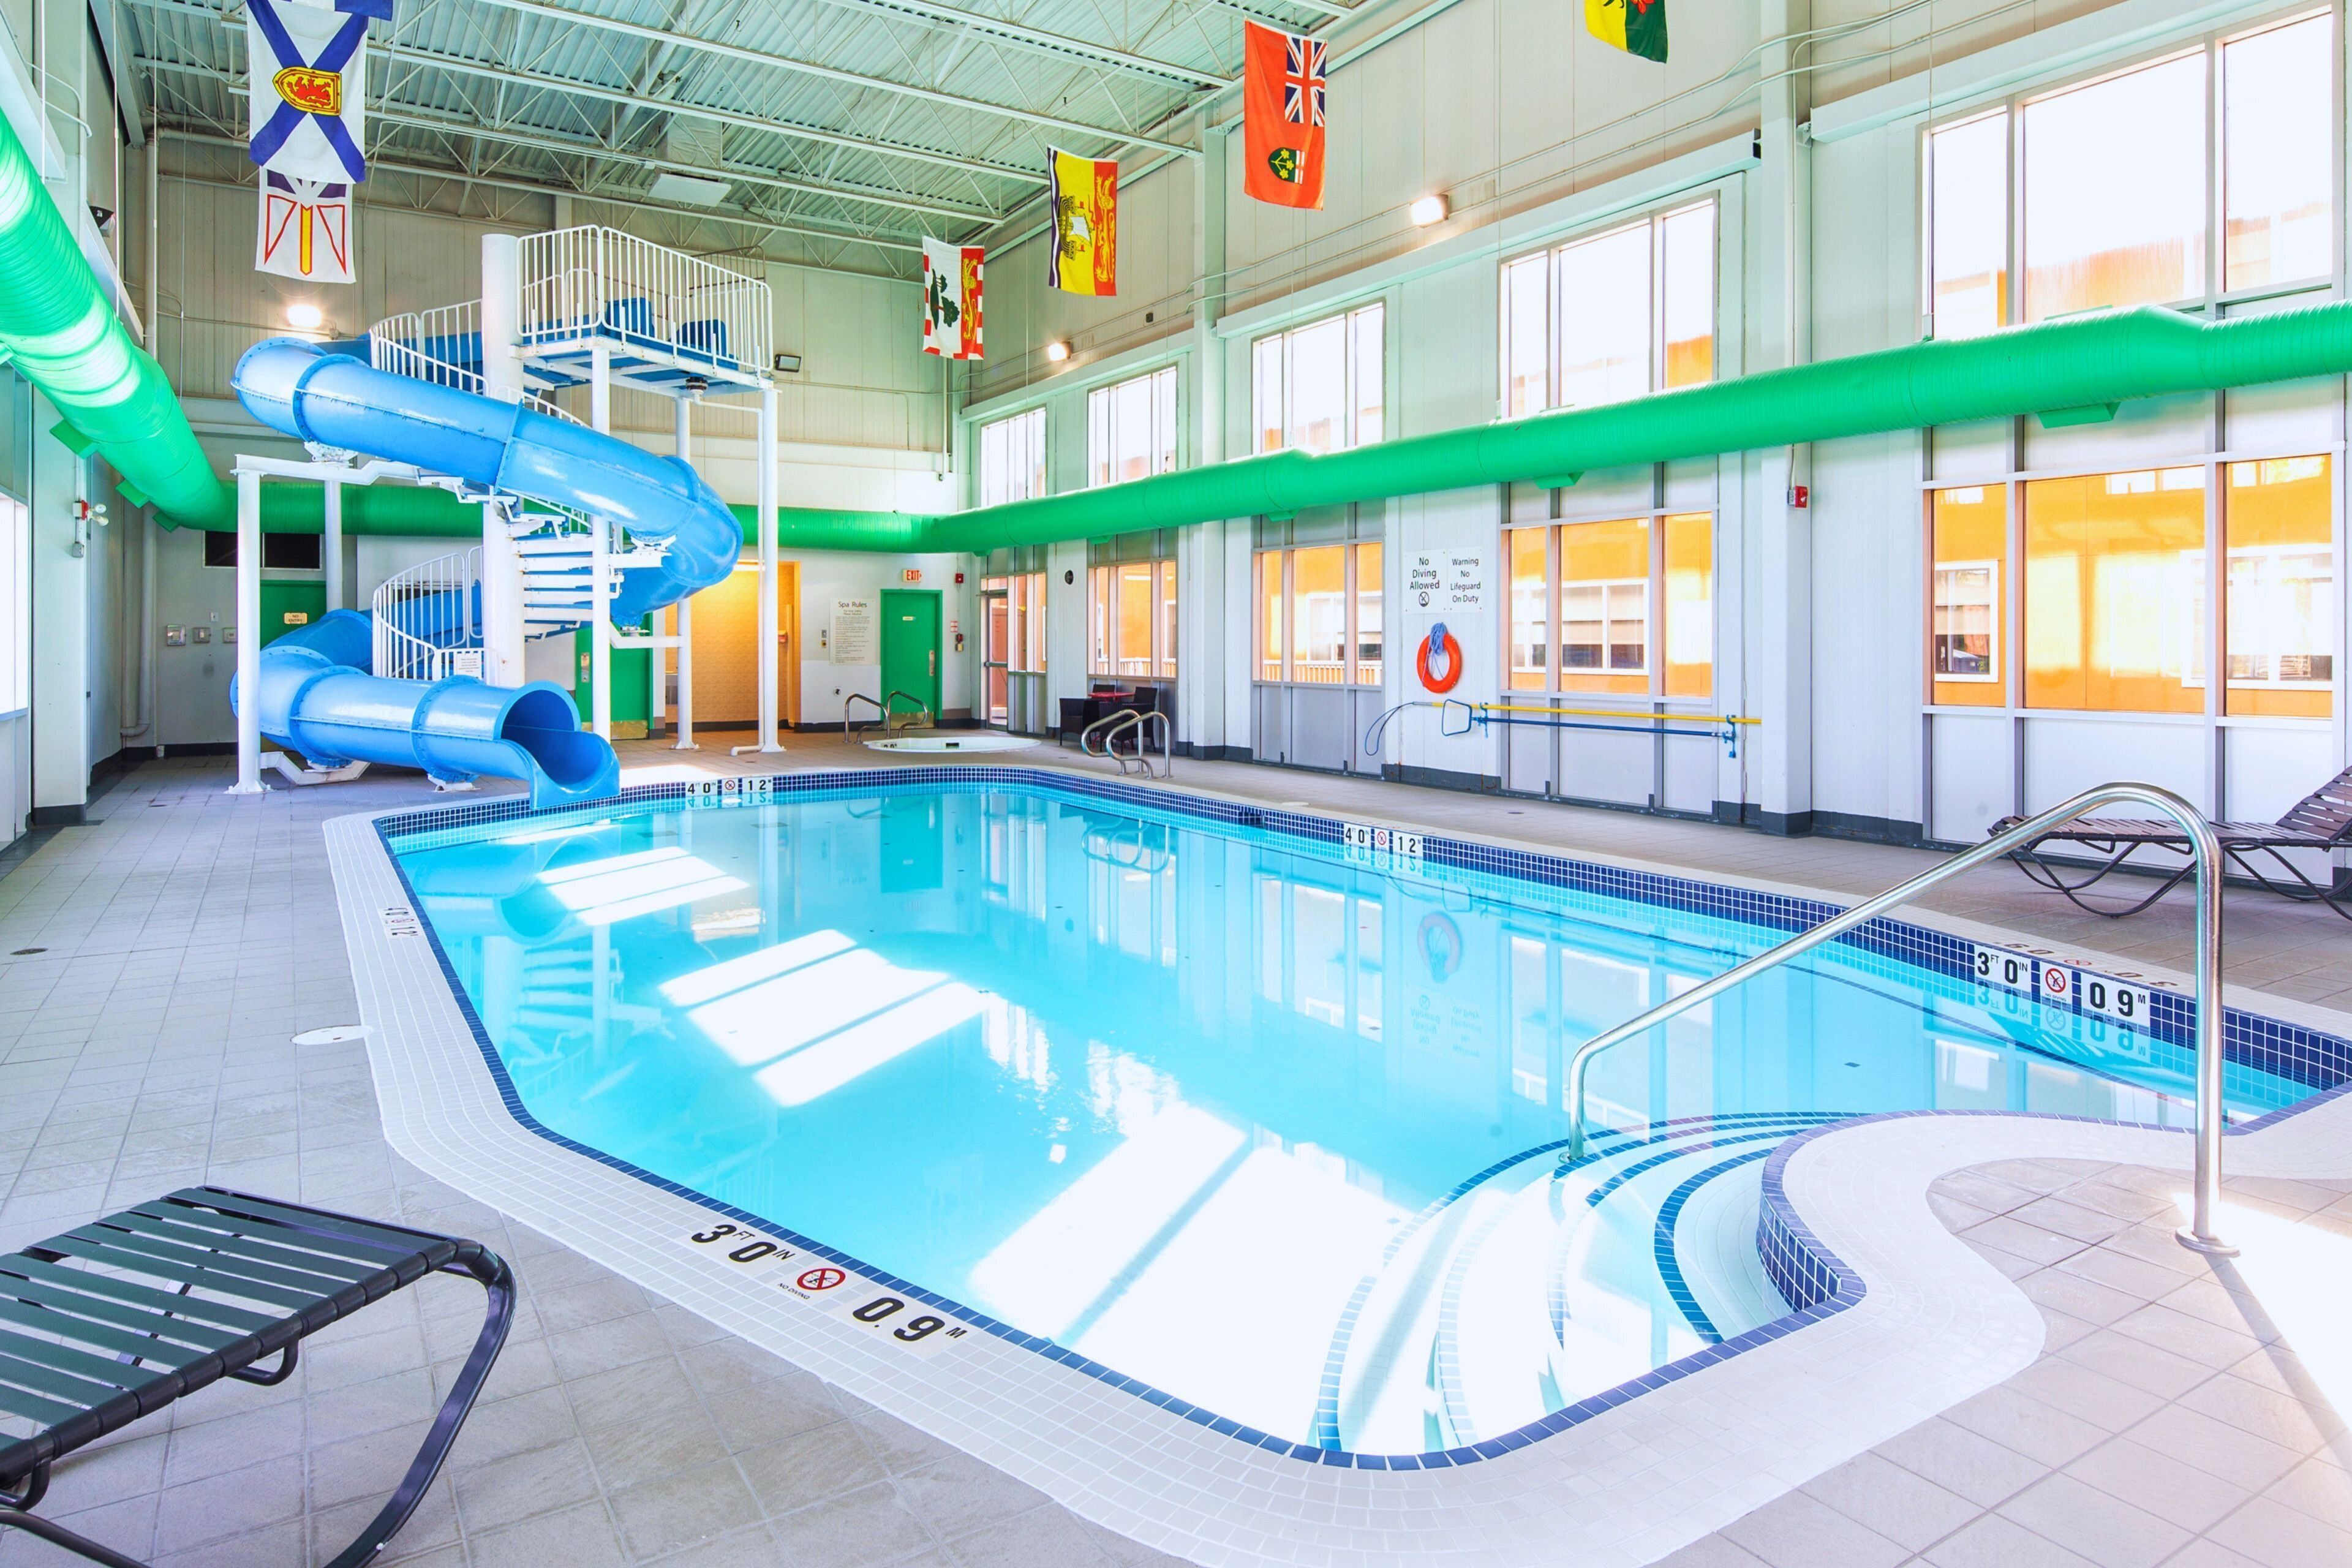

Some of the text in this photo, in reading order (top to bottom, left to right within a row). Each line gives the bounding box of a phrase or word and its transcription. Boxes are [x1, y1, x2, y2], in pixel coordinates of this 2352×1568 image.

[1419, 557, 1430, 565] No
[1452, 558, 1479, 567] Warning
[907, 570, 919, 581] EXIT
[1412, 568, 1436, 579] Diving
[1409, 580, 1440, 590] Allowed
[1450, 581, 1481, 592] Lifeguard
[1463, 594, 1479, 604] Duty
[1977, 951, 1990, 976] 3
[2004, 959, 2018, 984] 0
[691, 1224, 737, 1243] 3
[729, 1242, 778, 1263] 0
[788, 1287, 810, 1300] DIVING
[853, 1297, 945, 1341] 0.9
